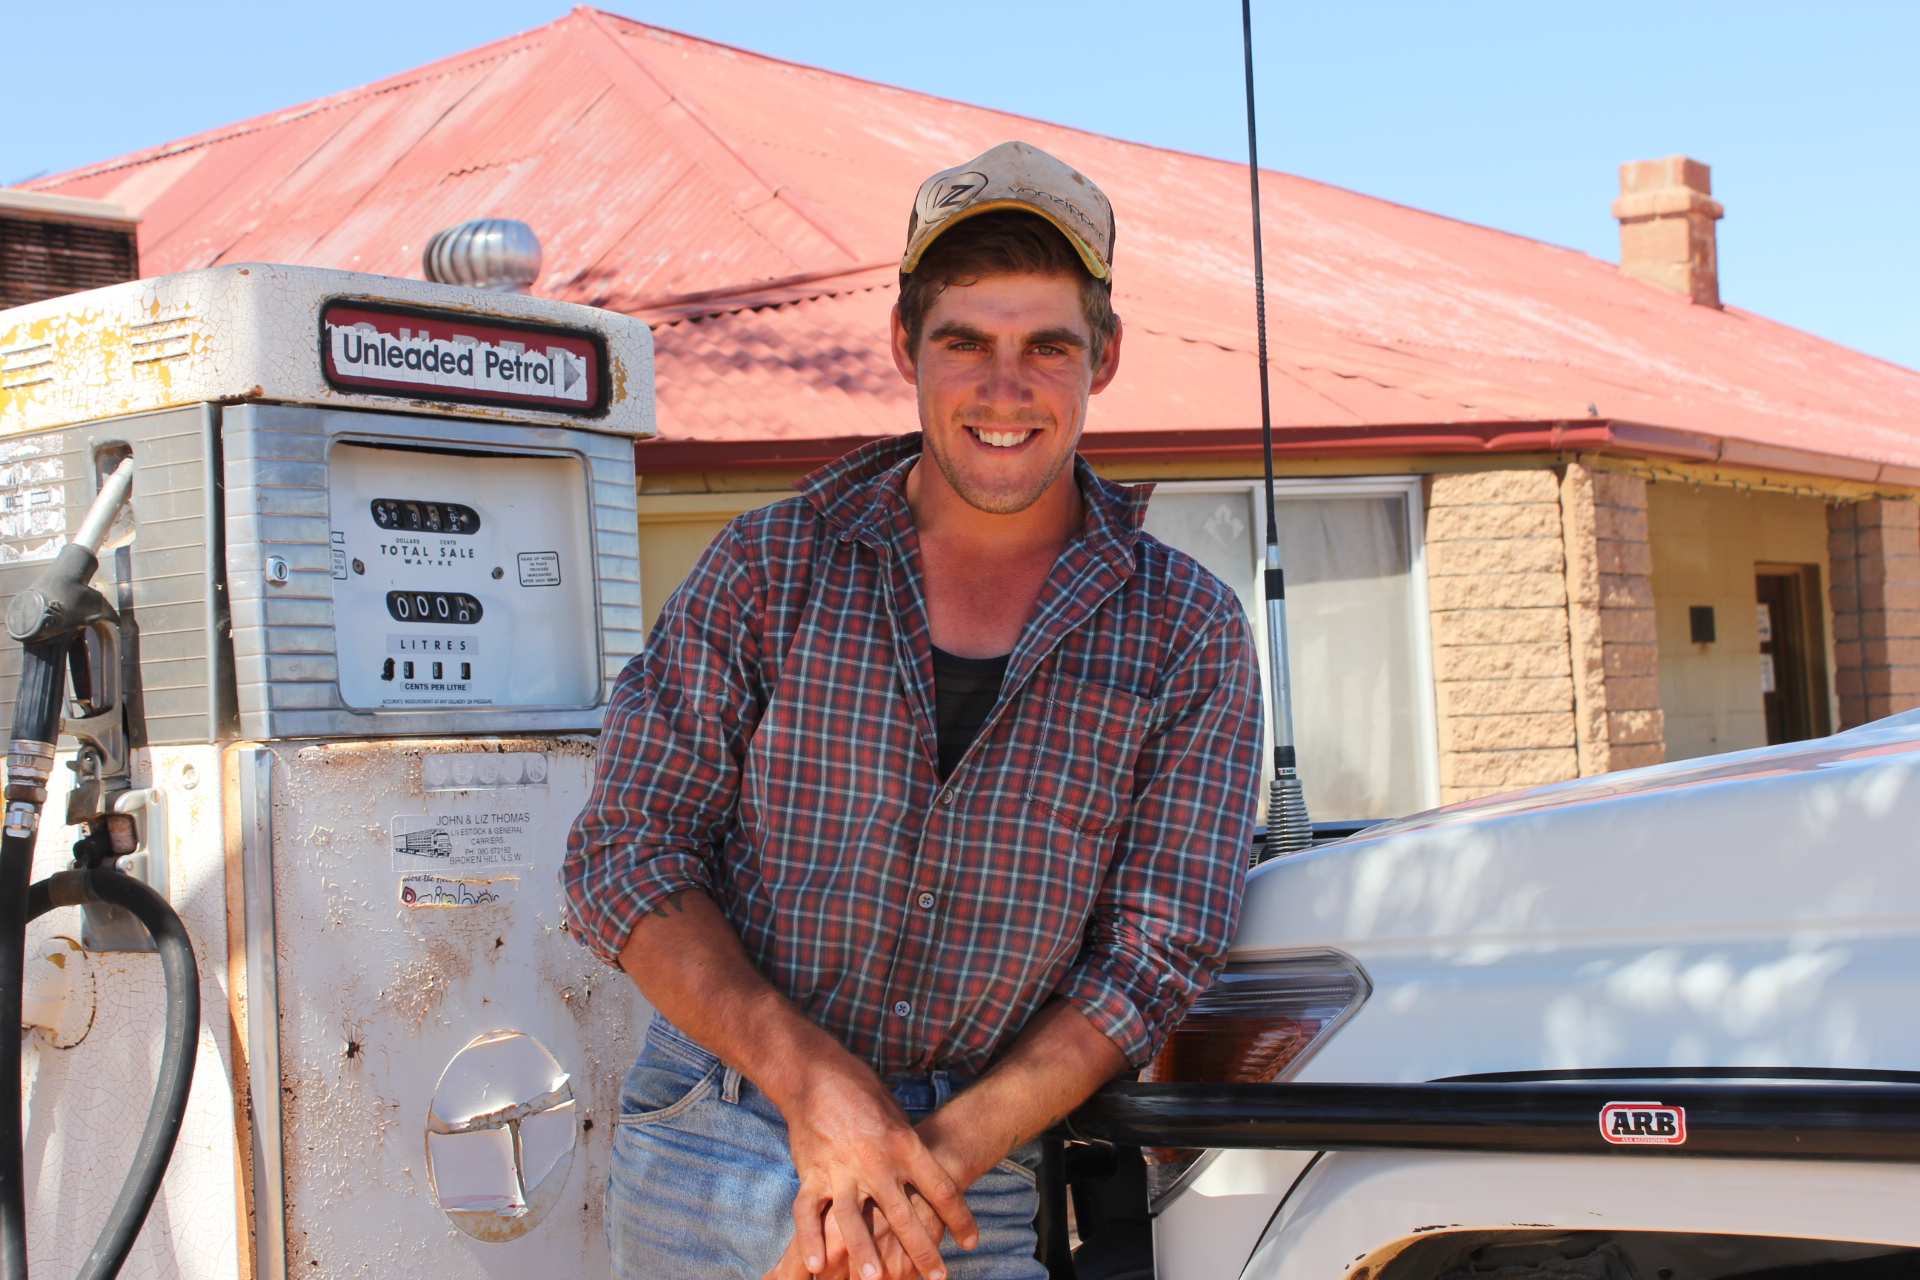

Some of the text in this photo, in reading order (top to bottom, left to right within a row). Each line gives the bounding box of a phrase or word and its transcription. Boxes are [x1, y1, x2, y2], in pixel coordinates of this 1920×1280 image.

[343, 333, 473, 377] Unleaded
[485, 350, 555, 386] Petrol
[380, 544, 474, 558] TOTAL SALE
[404, 559, 452, 567] WAYNE
[400, 639, 467, 650] LITRES
[405, 682, 429, 690] CENTS
[431, 683, 444, 691] PER
[436, 812, 530, 826] JOHN & LIZ THOMAS
[494, 826, 523, 834] GENERAL
[449, 856, 482, 865] BROKEN
[1611, 1111, 1676, 1136] ARB
